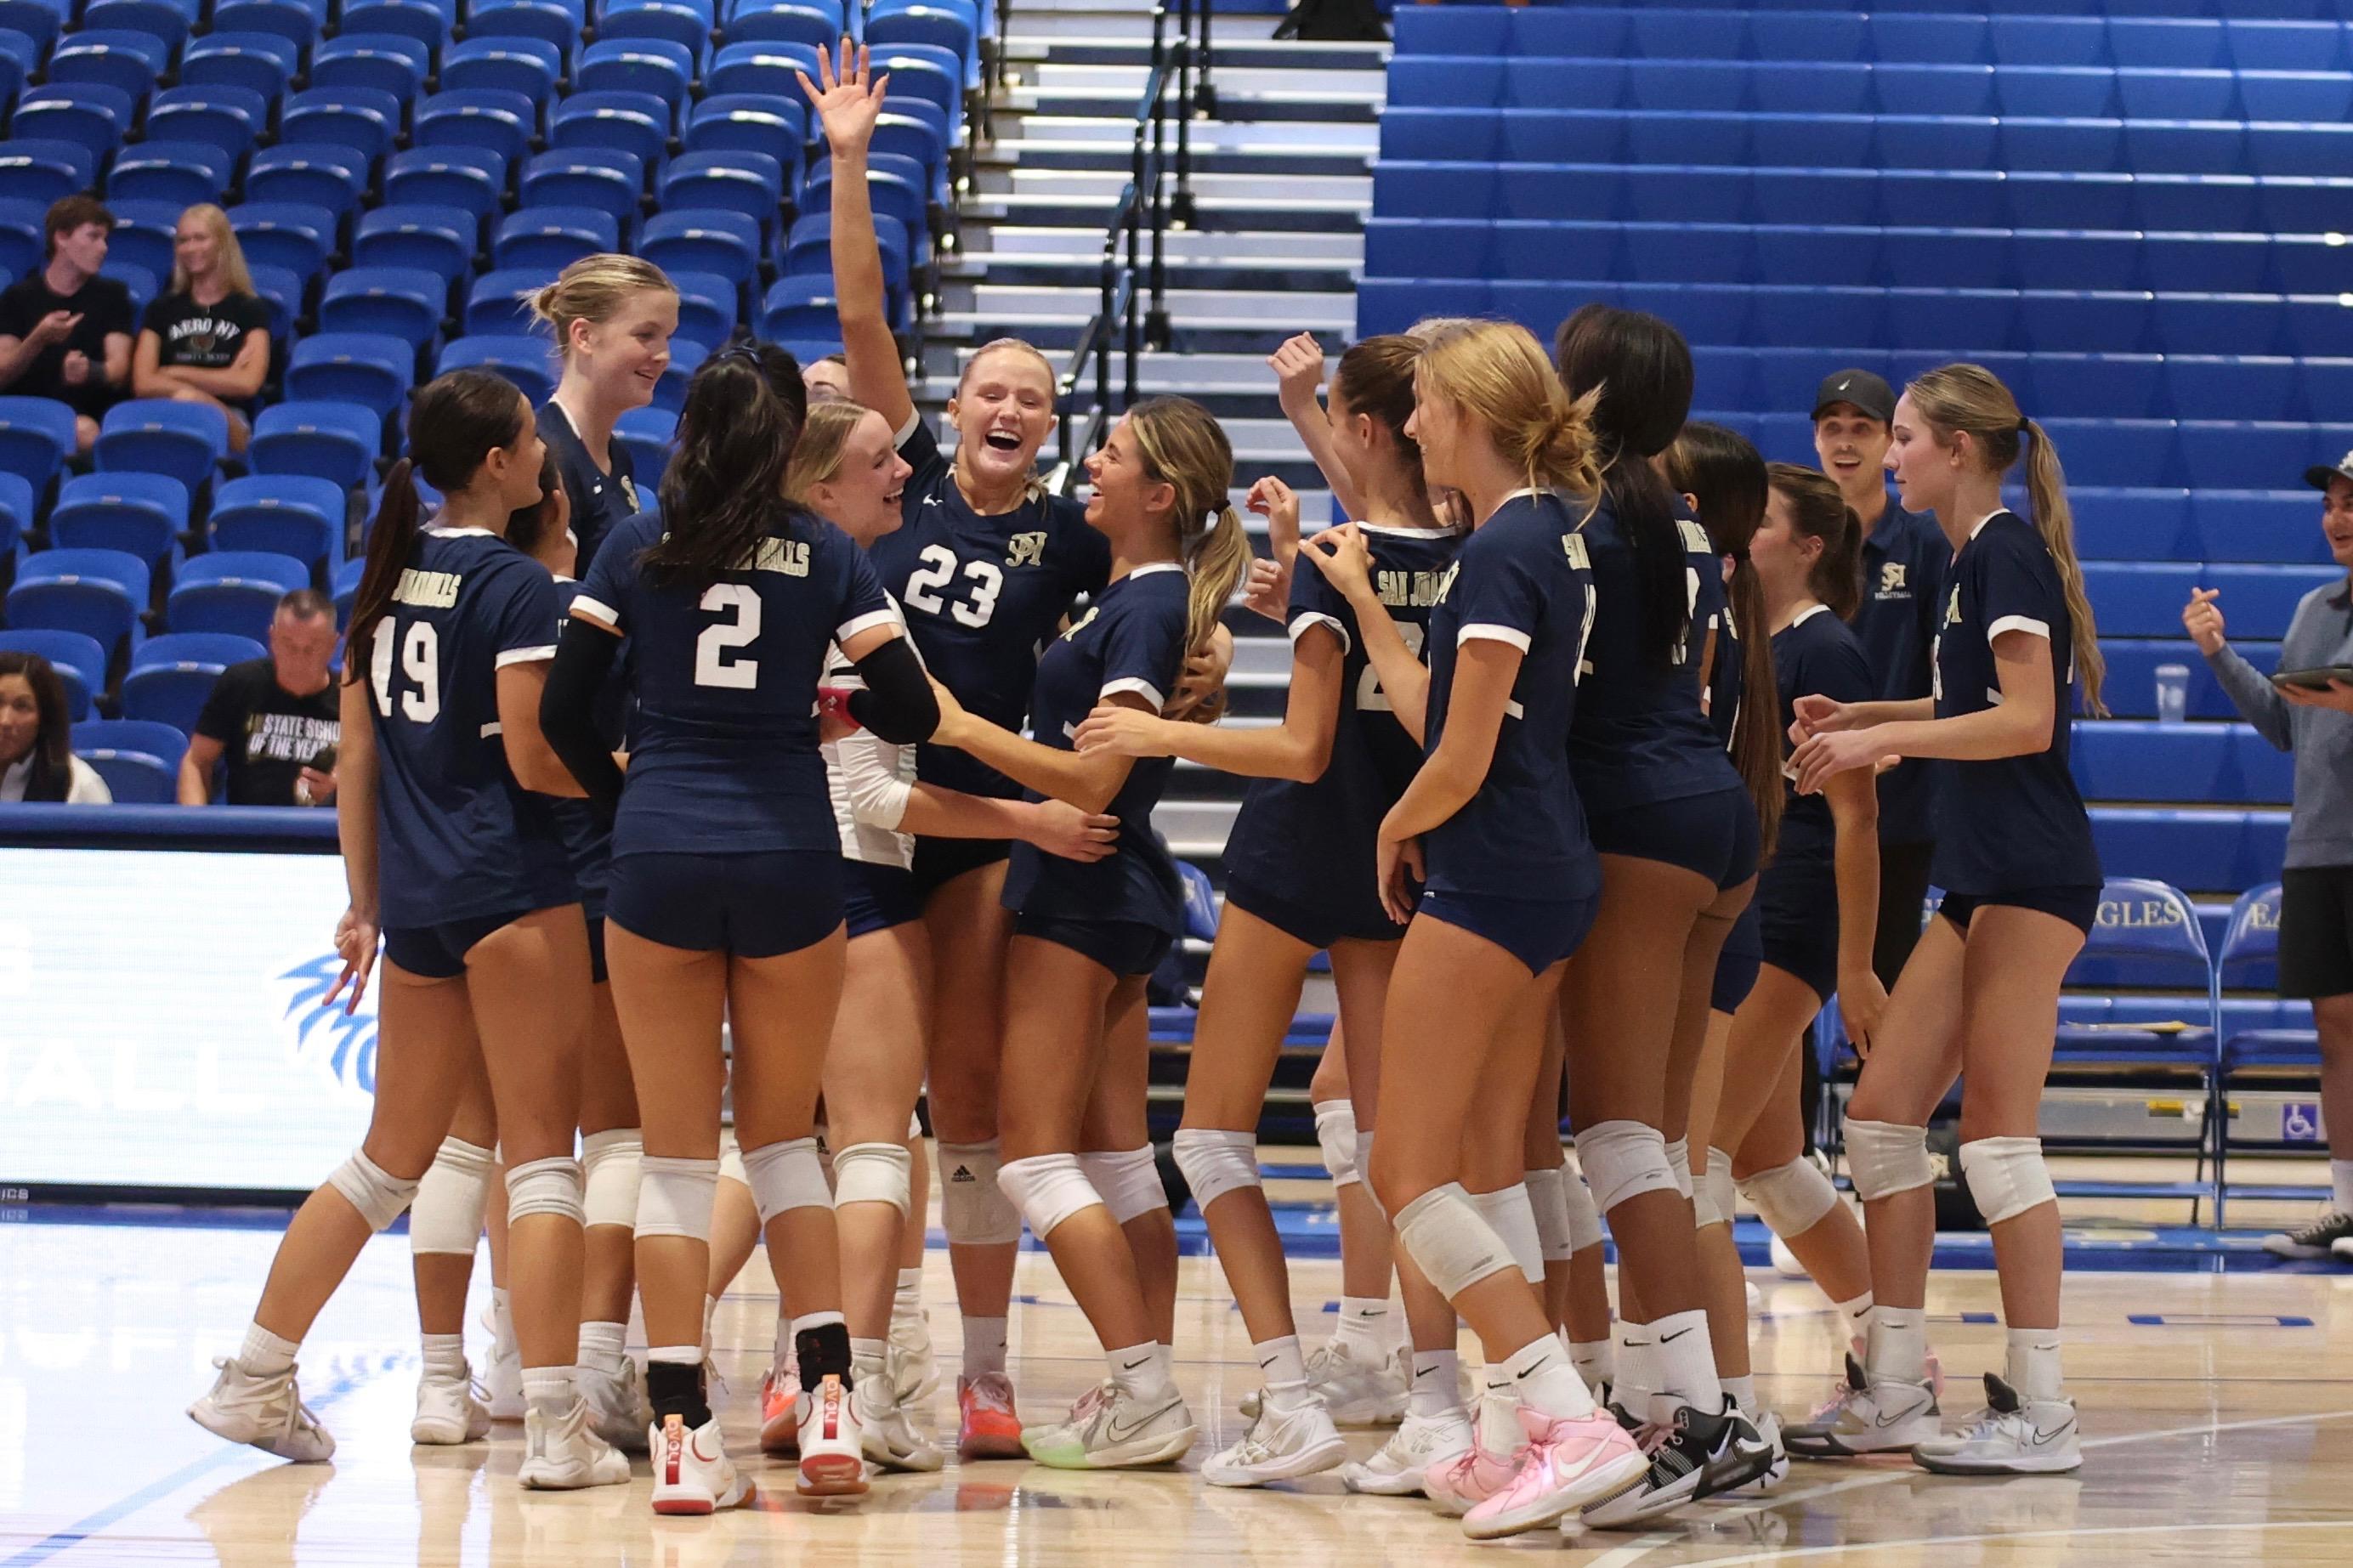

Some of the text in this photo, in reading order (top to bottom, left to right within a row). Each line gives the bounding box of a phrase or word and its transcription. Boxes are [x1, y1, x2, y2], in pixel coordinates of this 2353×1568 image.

[904, 544, 1004, 628] 23
[1377, 570, 1409, 607] SAN
[1409, 571, 1447, 607] JUA
[695, 583, 762, 689] 2
[371, 615, 440, 722] 19
[248, 733, 267, 756] OF
[268, 734, 292, 761] THE
[264, 713, 305, 738] STATE
